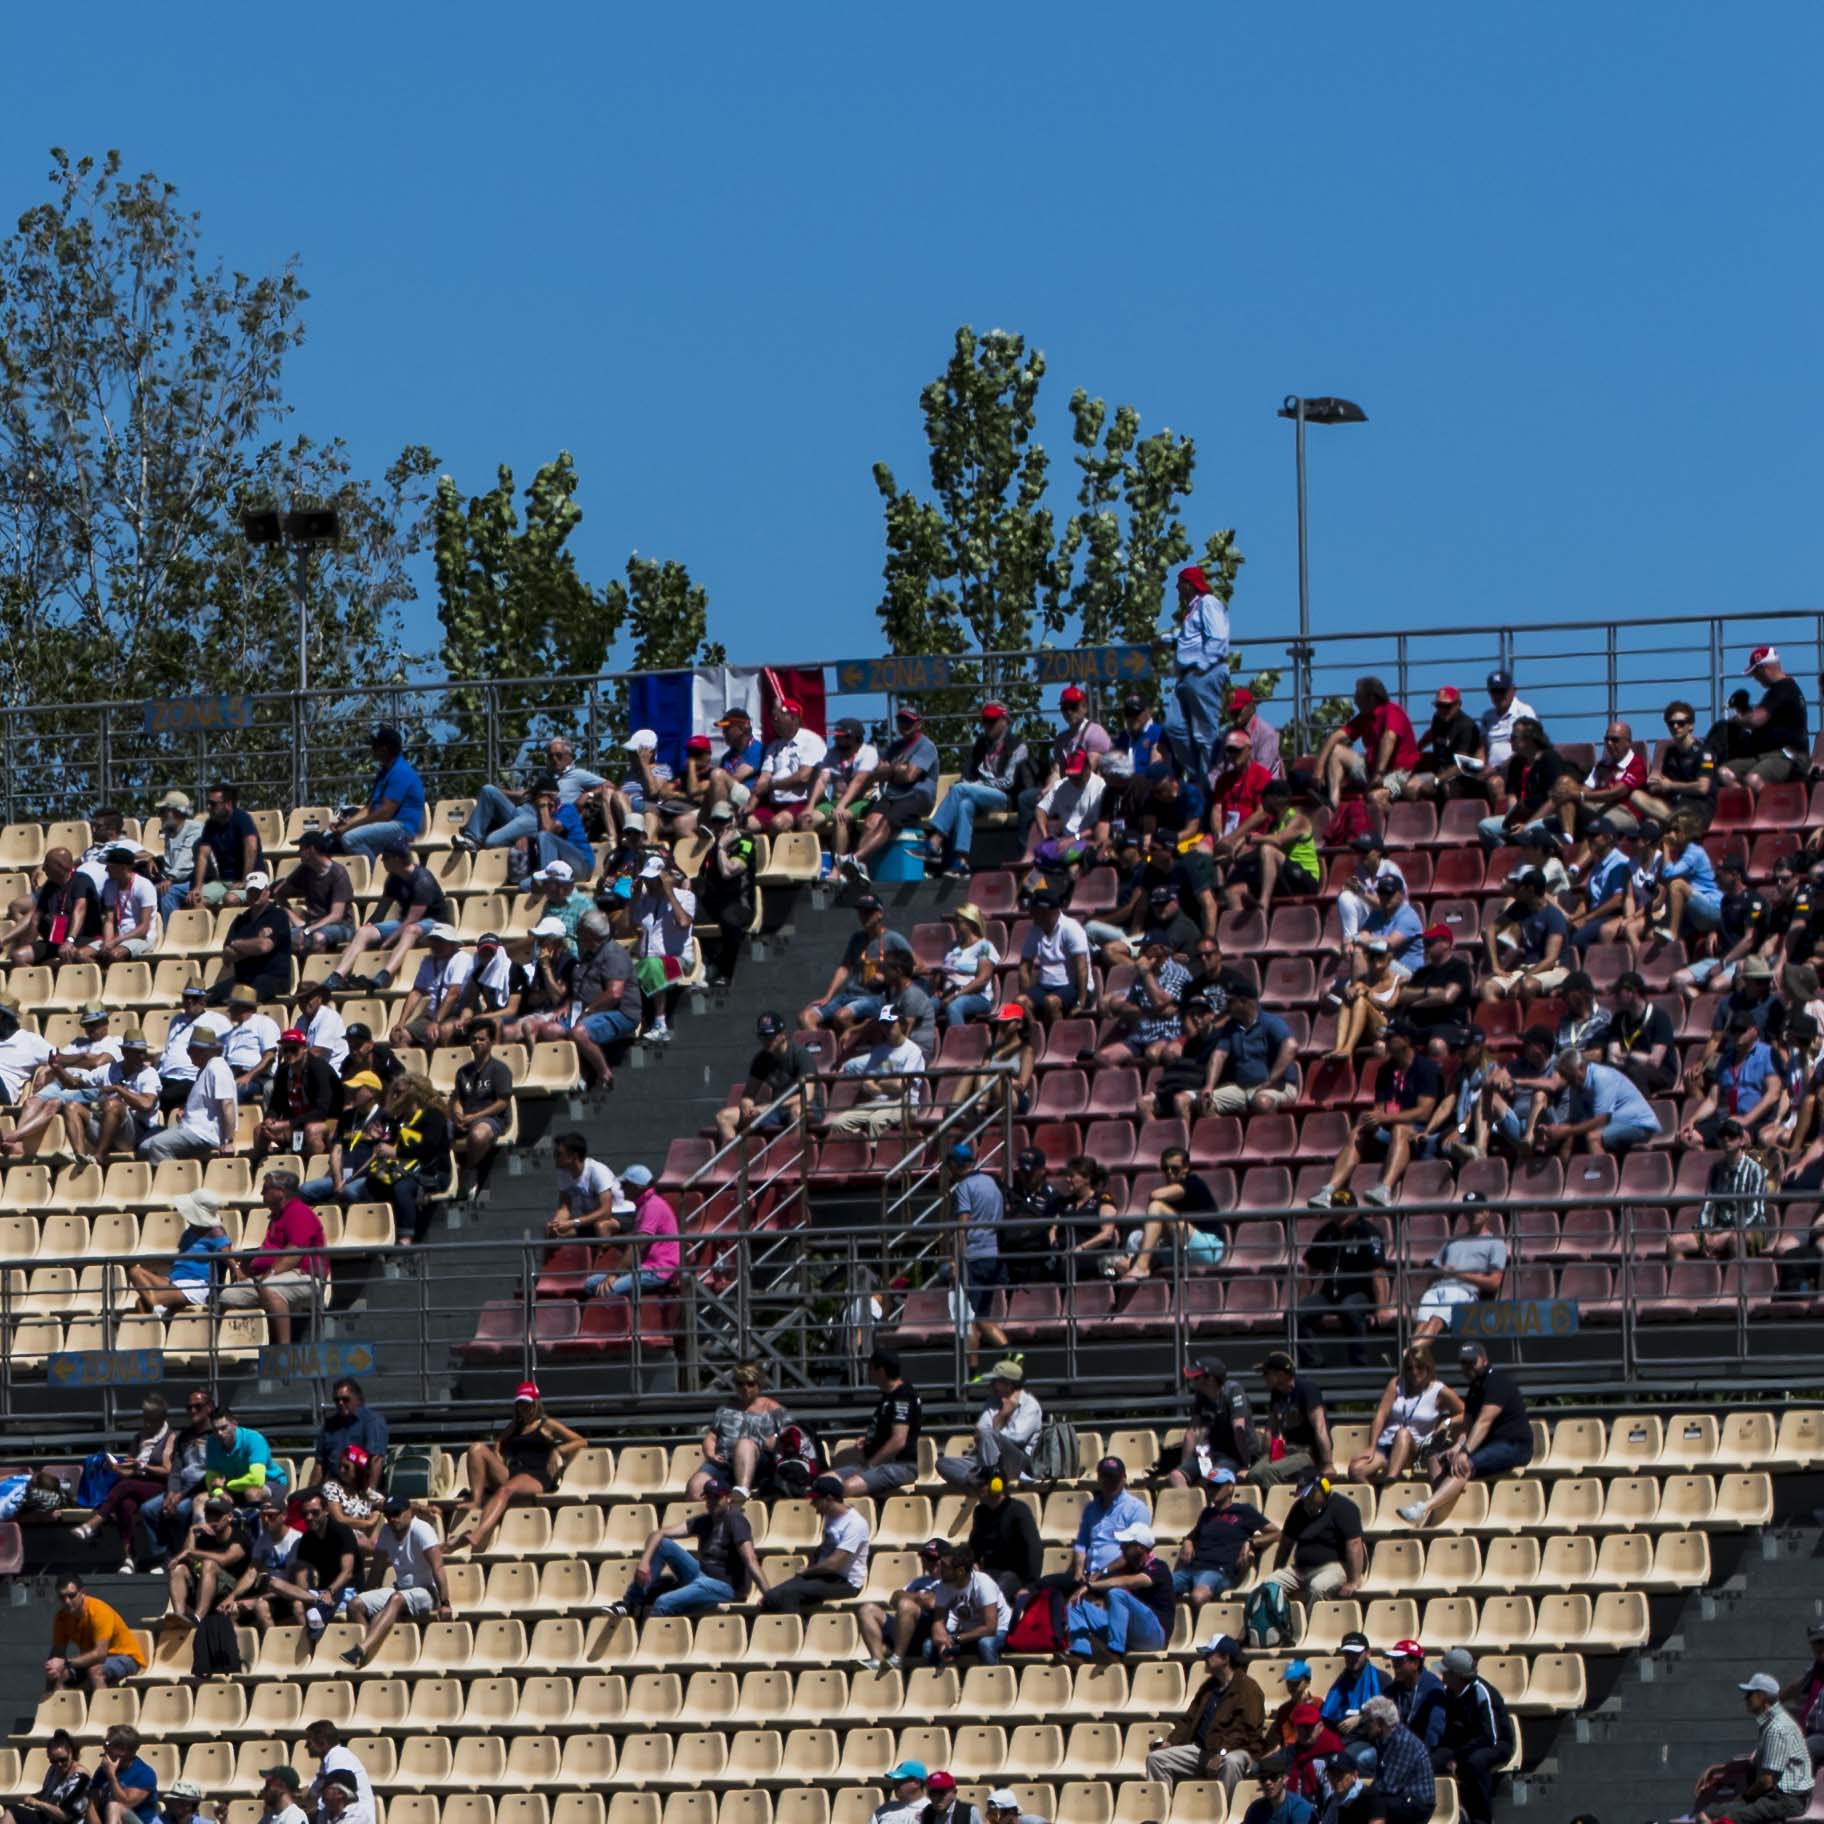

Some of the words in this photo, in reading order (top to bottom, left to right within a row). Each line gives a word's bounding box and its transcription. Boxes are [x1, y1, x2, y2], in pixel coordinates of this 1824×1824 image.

[868, 660, 929, 690] ZONA
[1041, 652, 1098, 681] ZONA
[1104, 650, 1119, 678] 6
[151, 699, 224, 729] ZONA
[231, 698, 245, 725] 5
[1460, 1302, 1540, 1334] ZONA
[1552, 1303, 1570, 1334] 6
[81, 1354, 140, 1385] ZONA
[147, 1353, 159, 1381] 5
